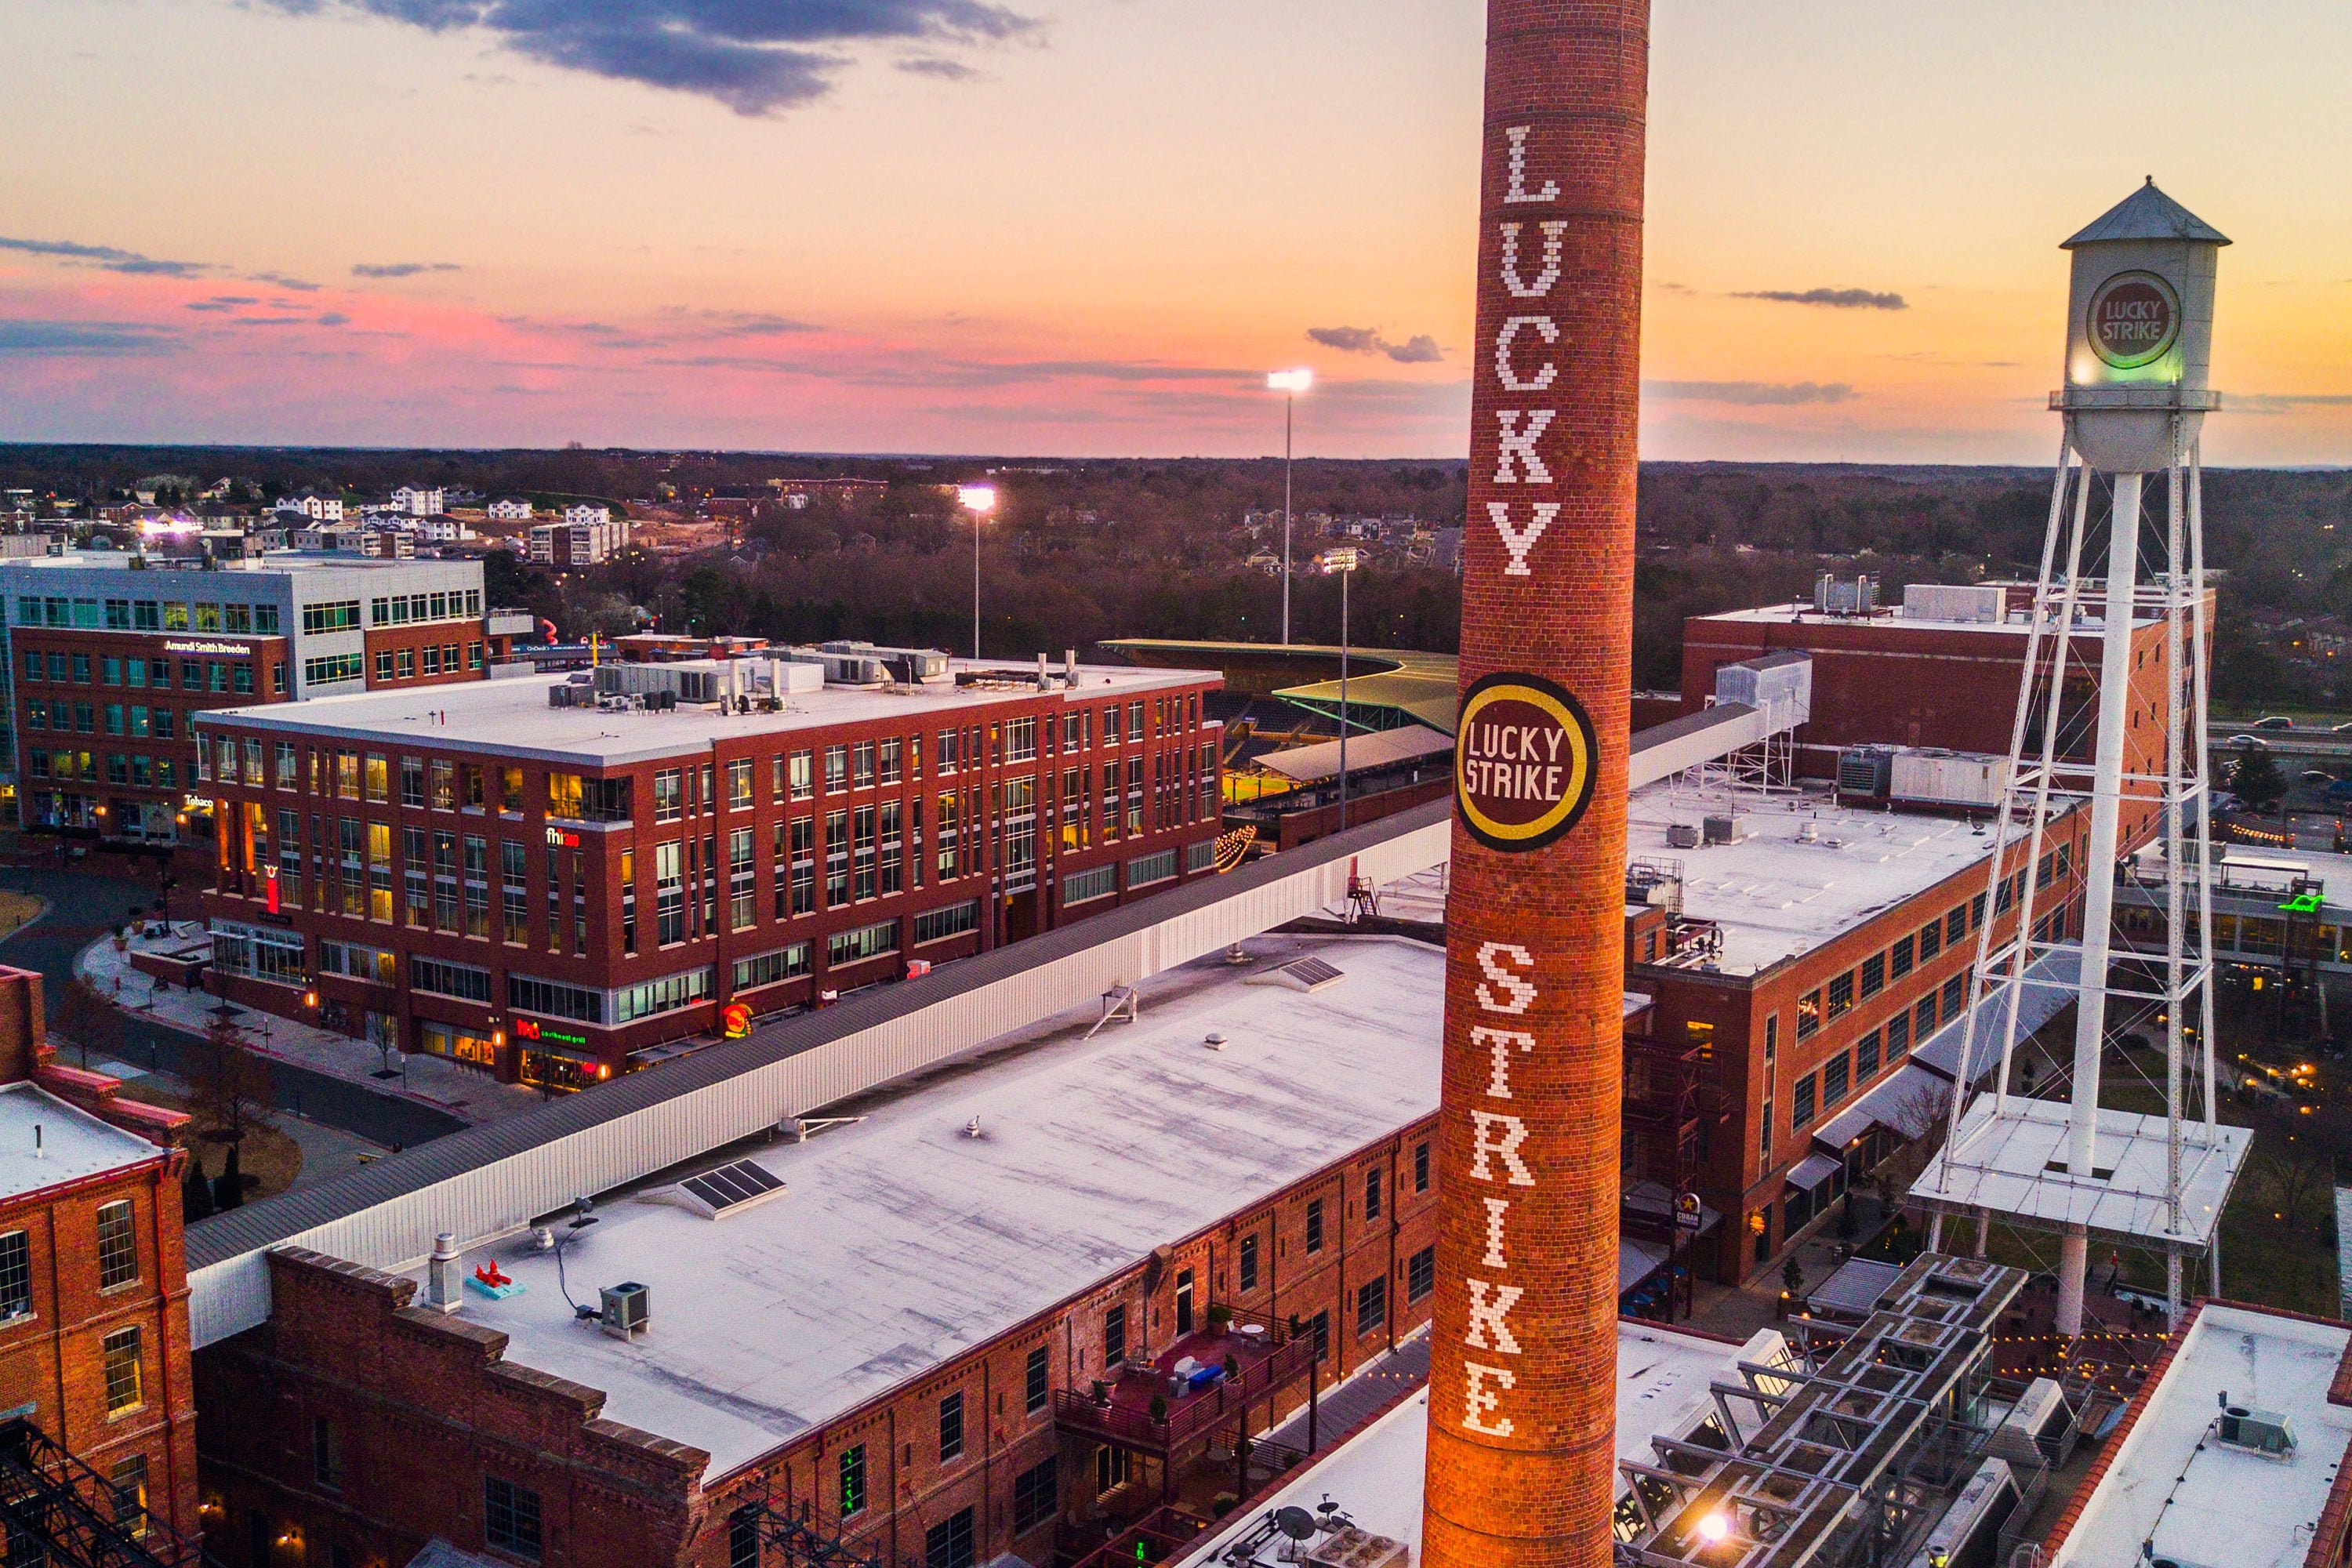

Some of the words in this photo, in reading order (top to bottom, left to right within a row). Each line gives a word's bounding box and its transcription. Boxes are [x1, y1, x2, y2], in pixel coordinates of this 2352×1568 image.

[2103, 321, 2161, 340] STRIKE
[2106, 301, 2161, 319] LUCKY
[1486, 125, 1568, 575] LUCKY
[165, 640, 194, 651] Amundi
[195, 642, 217, 653] Smith
[218, 643, 250, 654] Breeden
[1468, 721, 1564, 762] LUCKY
[1465, 759, 1563, 801] STRIKE
[1461, 941, 1537, 1436] STRIKE
